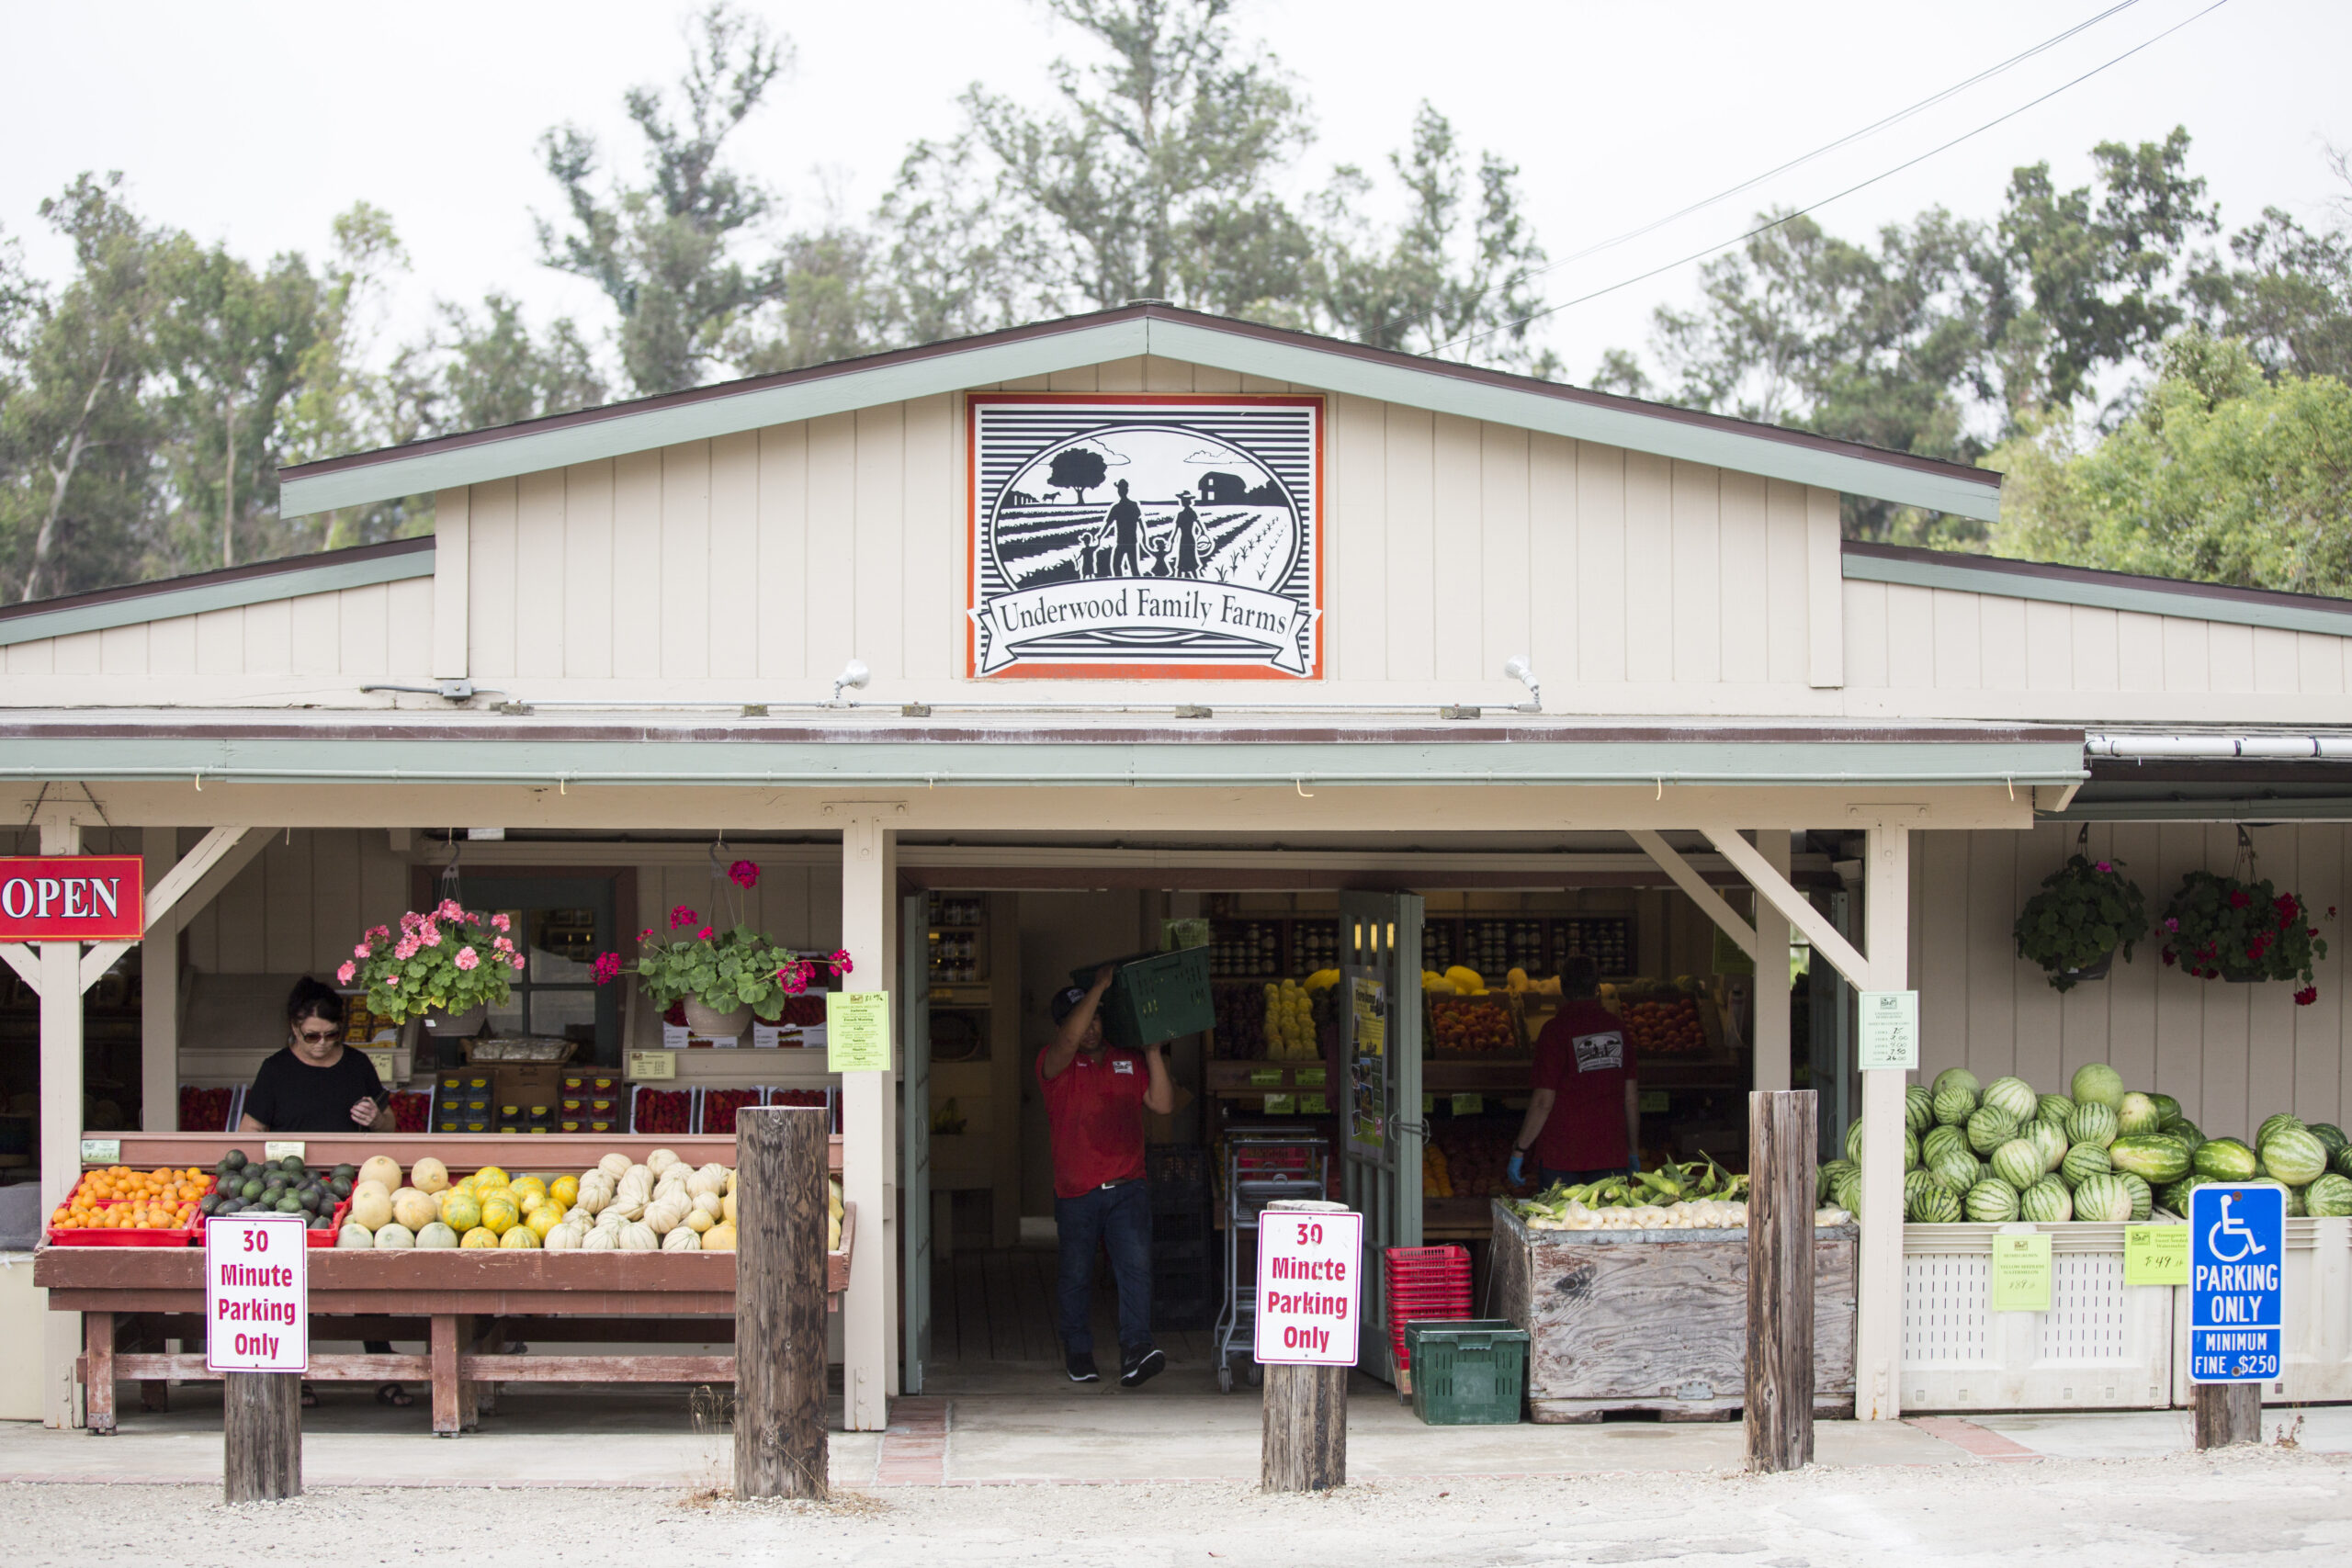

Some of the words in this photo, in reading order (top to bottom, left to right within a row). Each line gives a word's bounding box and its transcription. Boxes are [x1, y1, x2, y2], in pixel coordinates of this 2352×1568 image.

[1000, 588, 1127, 631] Underwood
[1136, 588, 1212, 626] Family
[1220, 594, 1286, 634] Farms
[1, 877, 120, 919] OPEN
[243, 1230, 268, 1252] 30
[1296, 1224, 1323, 1246] 30
[220, 1264, 292, 1287] Minute
[1272, 1257, 1346, 1281] Minute
[2196, 1264, 2278, 1292] PARKING
[219, 1298, 296, 1325] Parking
[1268, 1292, 1348, 1320] Parking
[2211, 1295, 2262, 1323] ONLY
[235, 1333, 279, 1359] Only
[1283, 1326, 1329, 1353] Only
[2206, 1333, 2267, 1351] MINIMUM
[2195, 1356, 2227, 1374] FINE
[2238, 1355, 2277, 1375] $250
